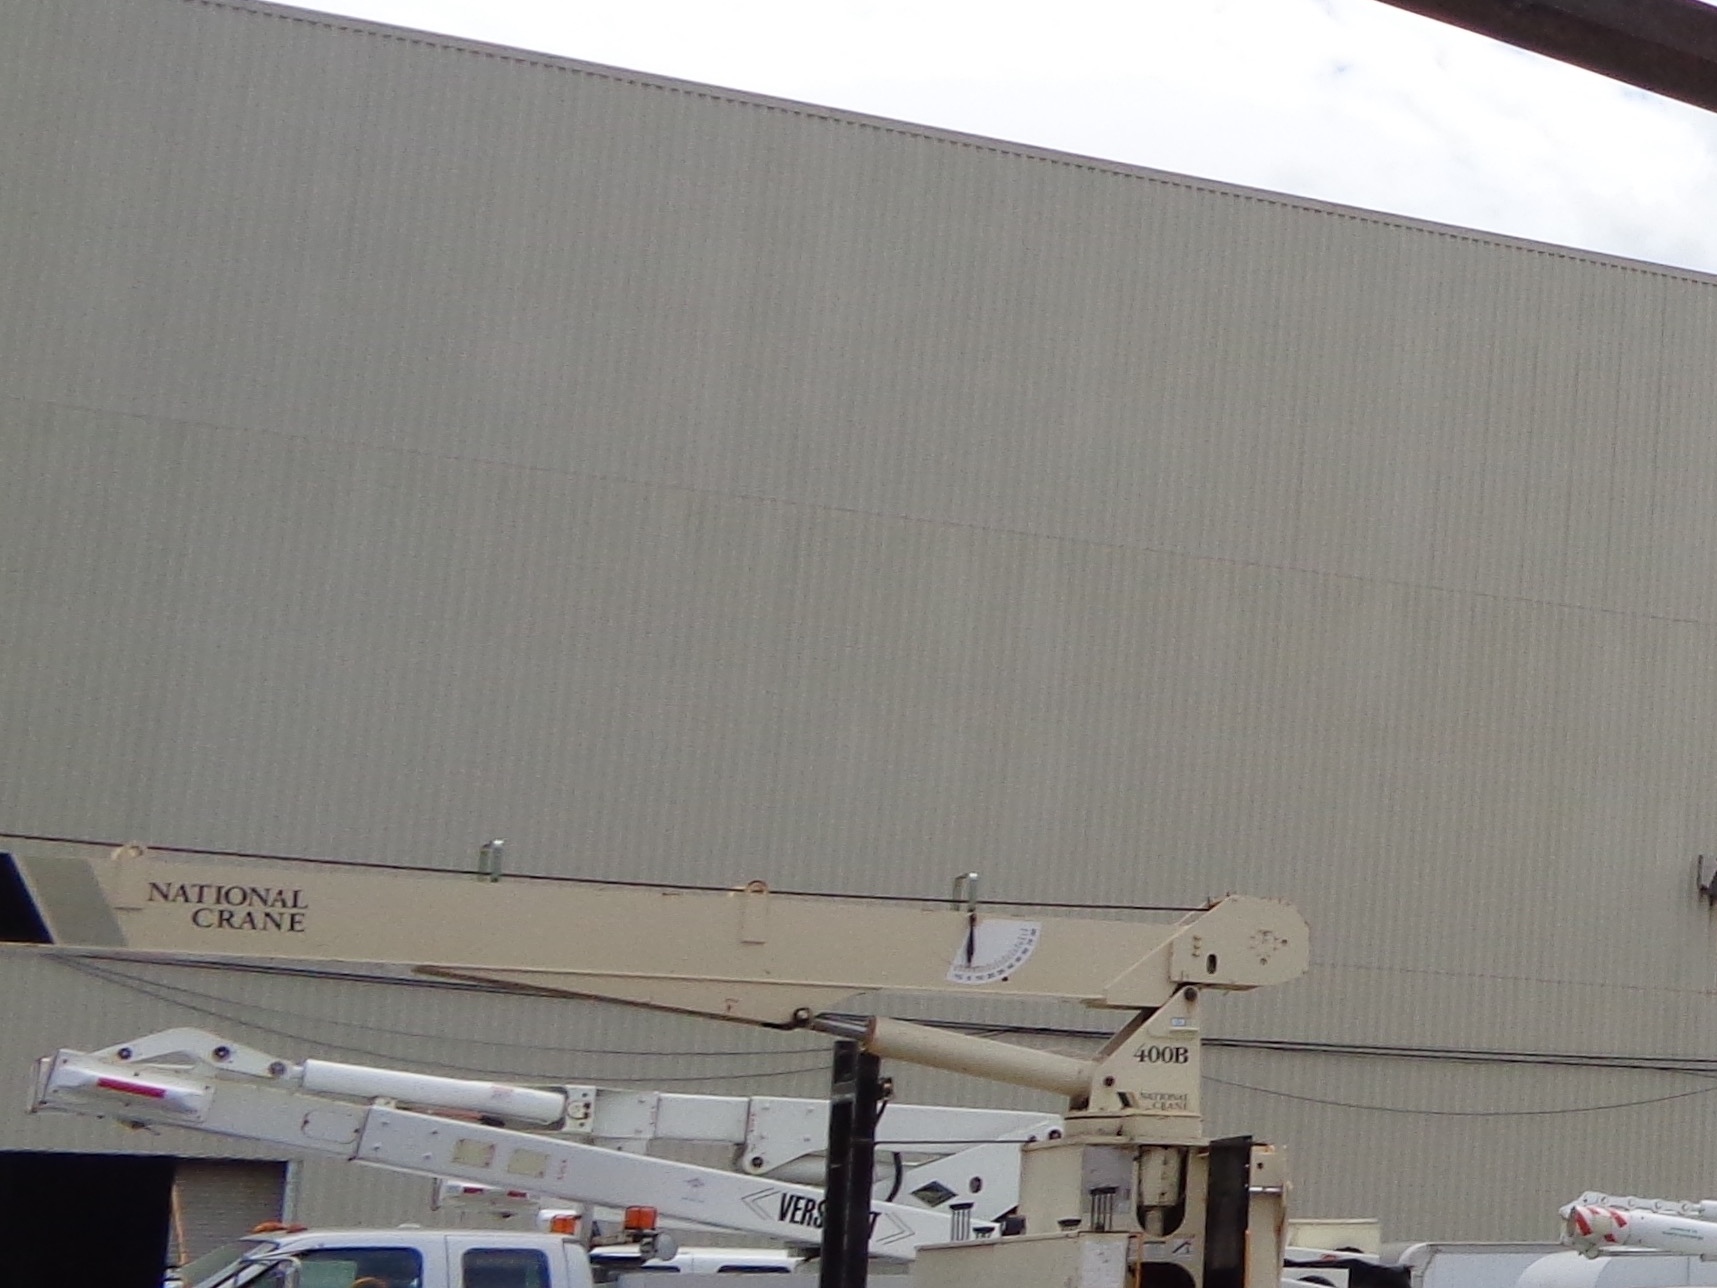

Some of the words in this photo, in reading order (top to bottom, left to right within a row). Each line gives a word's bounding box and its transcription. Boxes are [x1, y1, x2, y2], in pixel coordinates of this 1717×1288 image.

[147, 882, 309, 910] NATIONAL
[191, 907, 306, 933] CRANE
[1133, 1043, 1189, 1065] 400B
